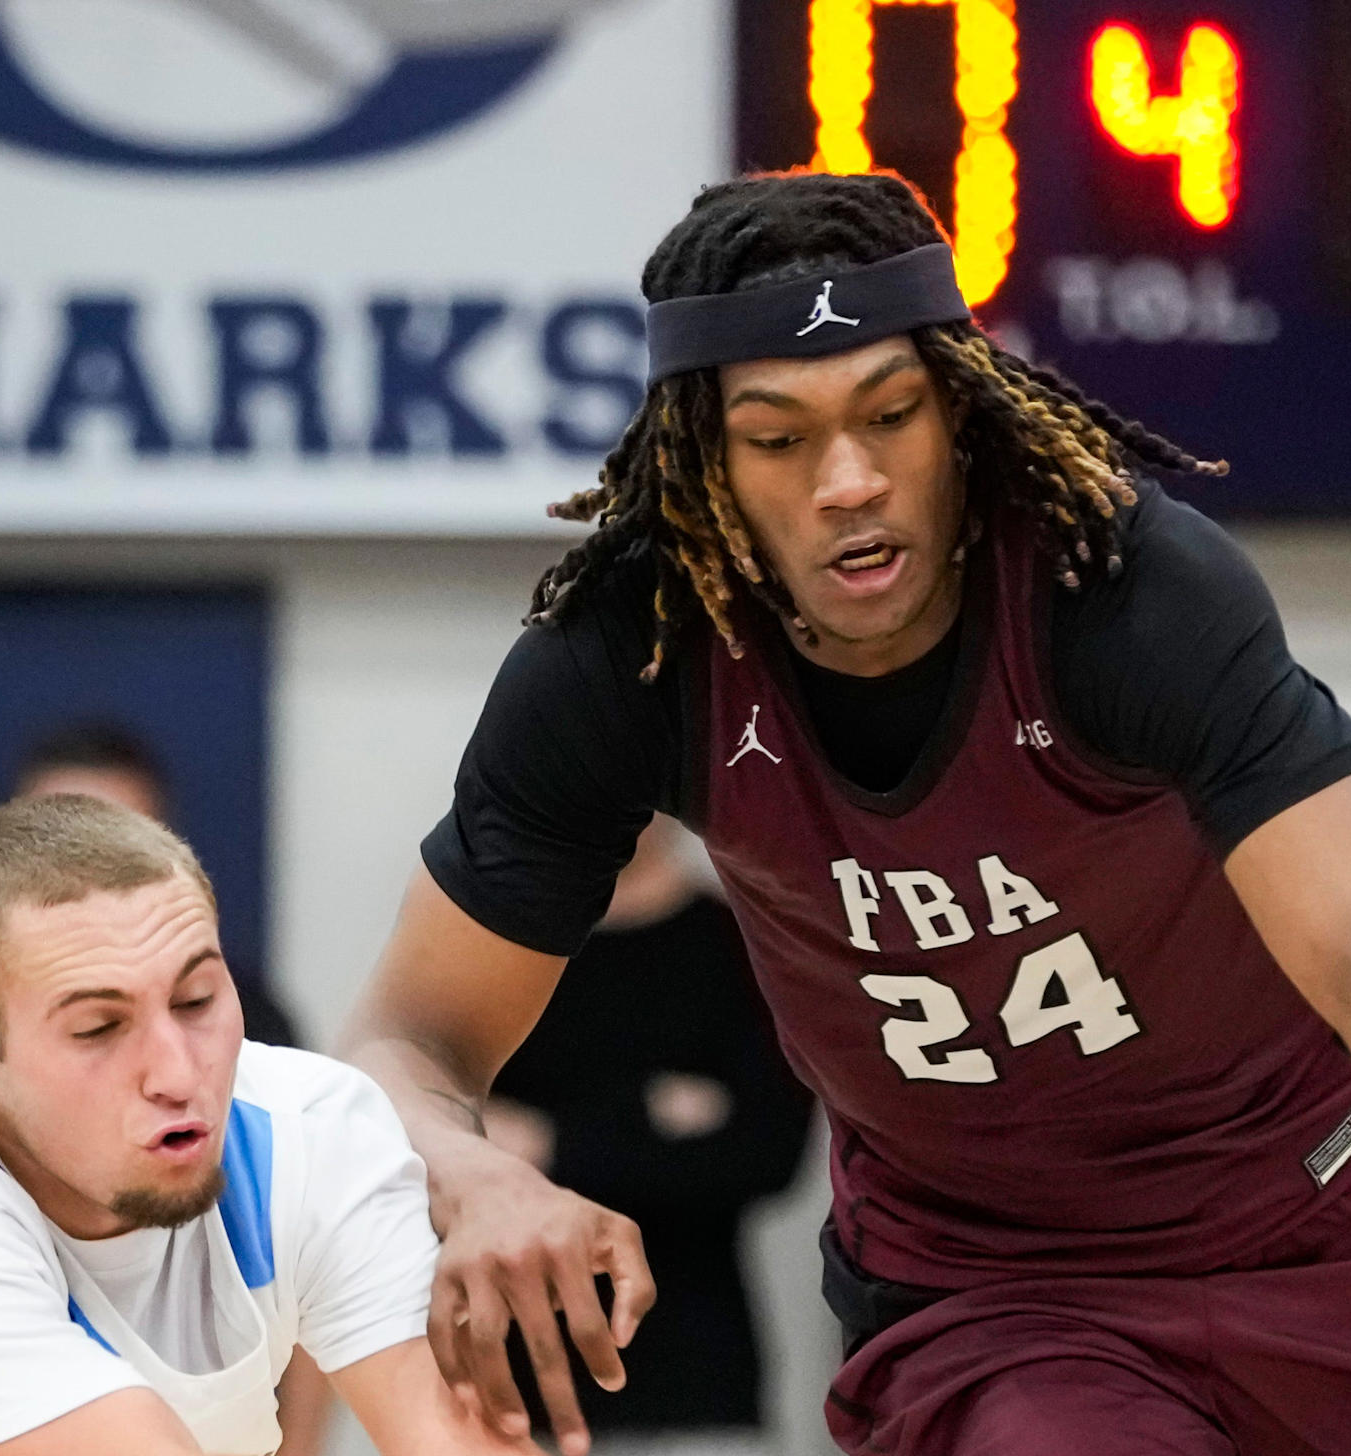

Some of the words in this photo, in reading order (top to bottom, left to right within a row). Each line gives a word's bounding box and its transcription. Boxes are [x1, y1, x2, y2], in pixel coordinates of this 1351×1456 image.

[1090, 22, 1239, 228] 4
[830, 855, 1060, 952] FBA
[857, 931, 1141, 1084] 24
